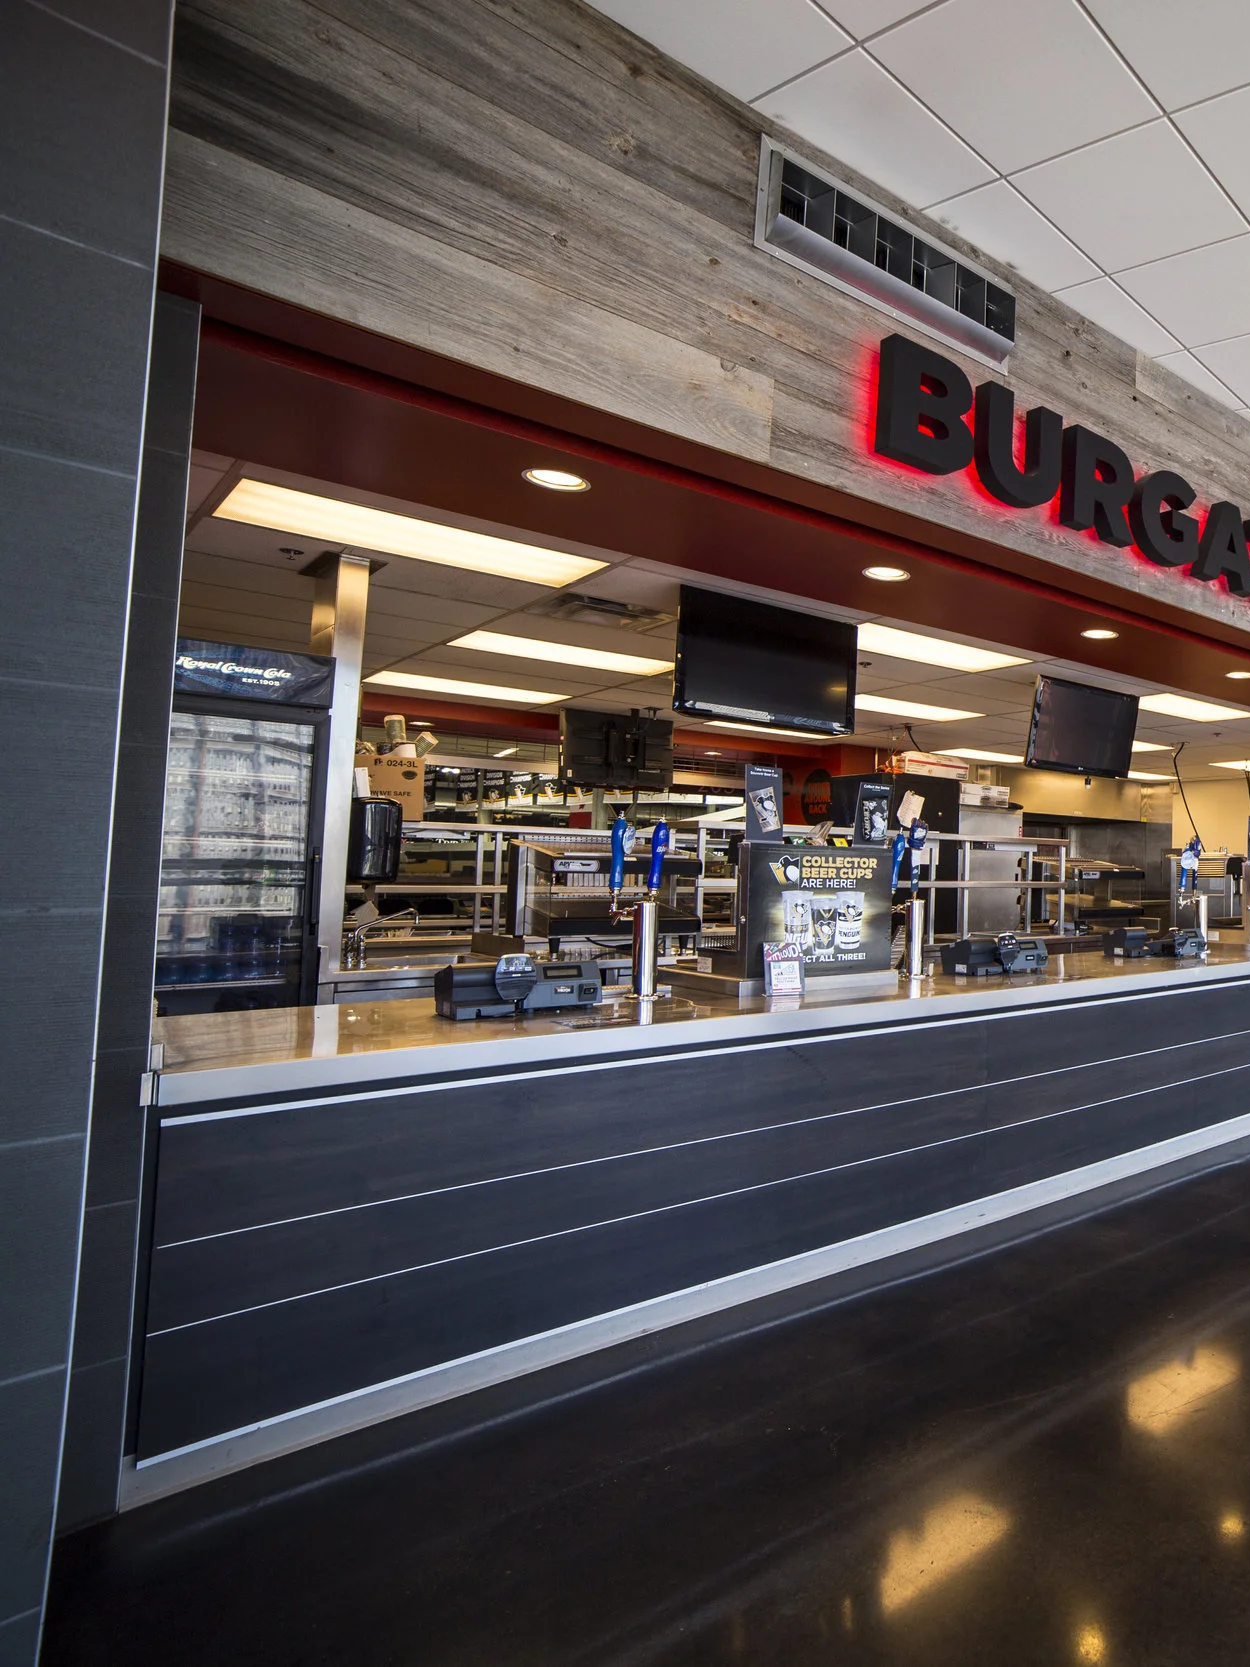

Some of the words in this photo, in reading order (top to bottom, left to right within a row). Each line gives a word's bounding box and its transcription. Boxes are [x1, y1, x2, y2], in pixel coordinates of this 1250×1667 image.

[176, 656, 223, 670] Royal
[221, 663, 263, 675] Crown
[263, 667, 292, 679] Cola
[386, 759, 418, 768] 024-3L
[802, 856, 878, 868] COLLECTOR
[802, 868, 837, 878] BEER
[840, 868, 873, 879] CUPS
[801, 879, 823, 888] ARE
[826, 879, 856, 888] HERE!
[819, 954, 835, 962] ALL
[837, 952, 866, 961] THREE!
